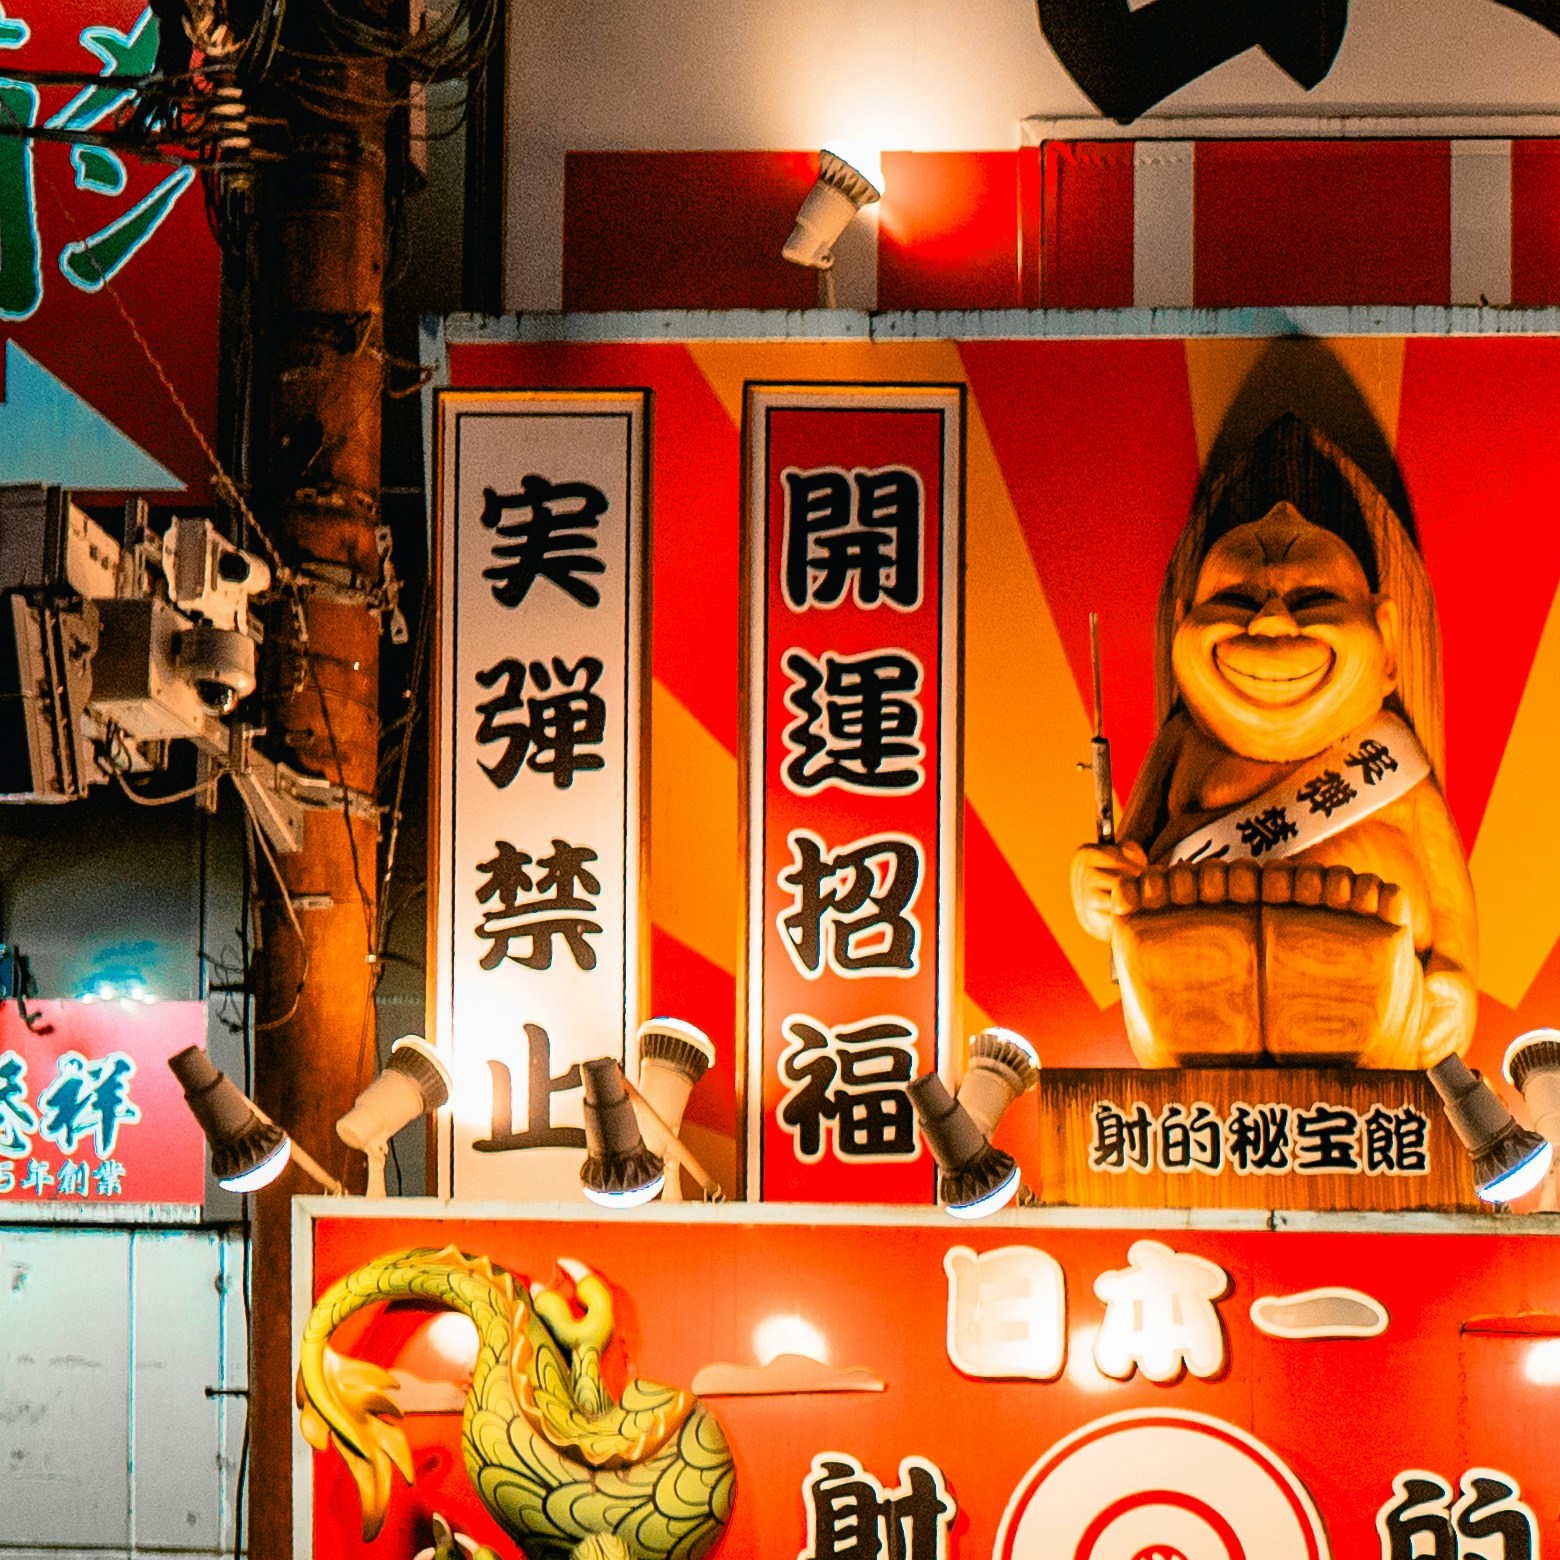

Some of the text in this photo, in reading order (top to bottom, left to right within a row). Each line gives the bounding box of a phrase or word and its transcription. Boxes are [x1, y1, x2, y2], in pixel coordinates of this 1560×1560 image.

[474, 474, 610, 1153] 実弾禁止
[776, 464, 926, 1164] 開運招福
[945, 1241, 1388, 1382] 日本一
[1091, 1101, 1428, 1176] 射的秘宝館
